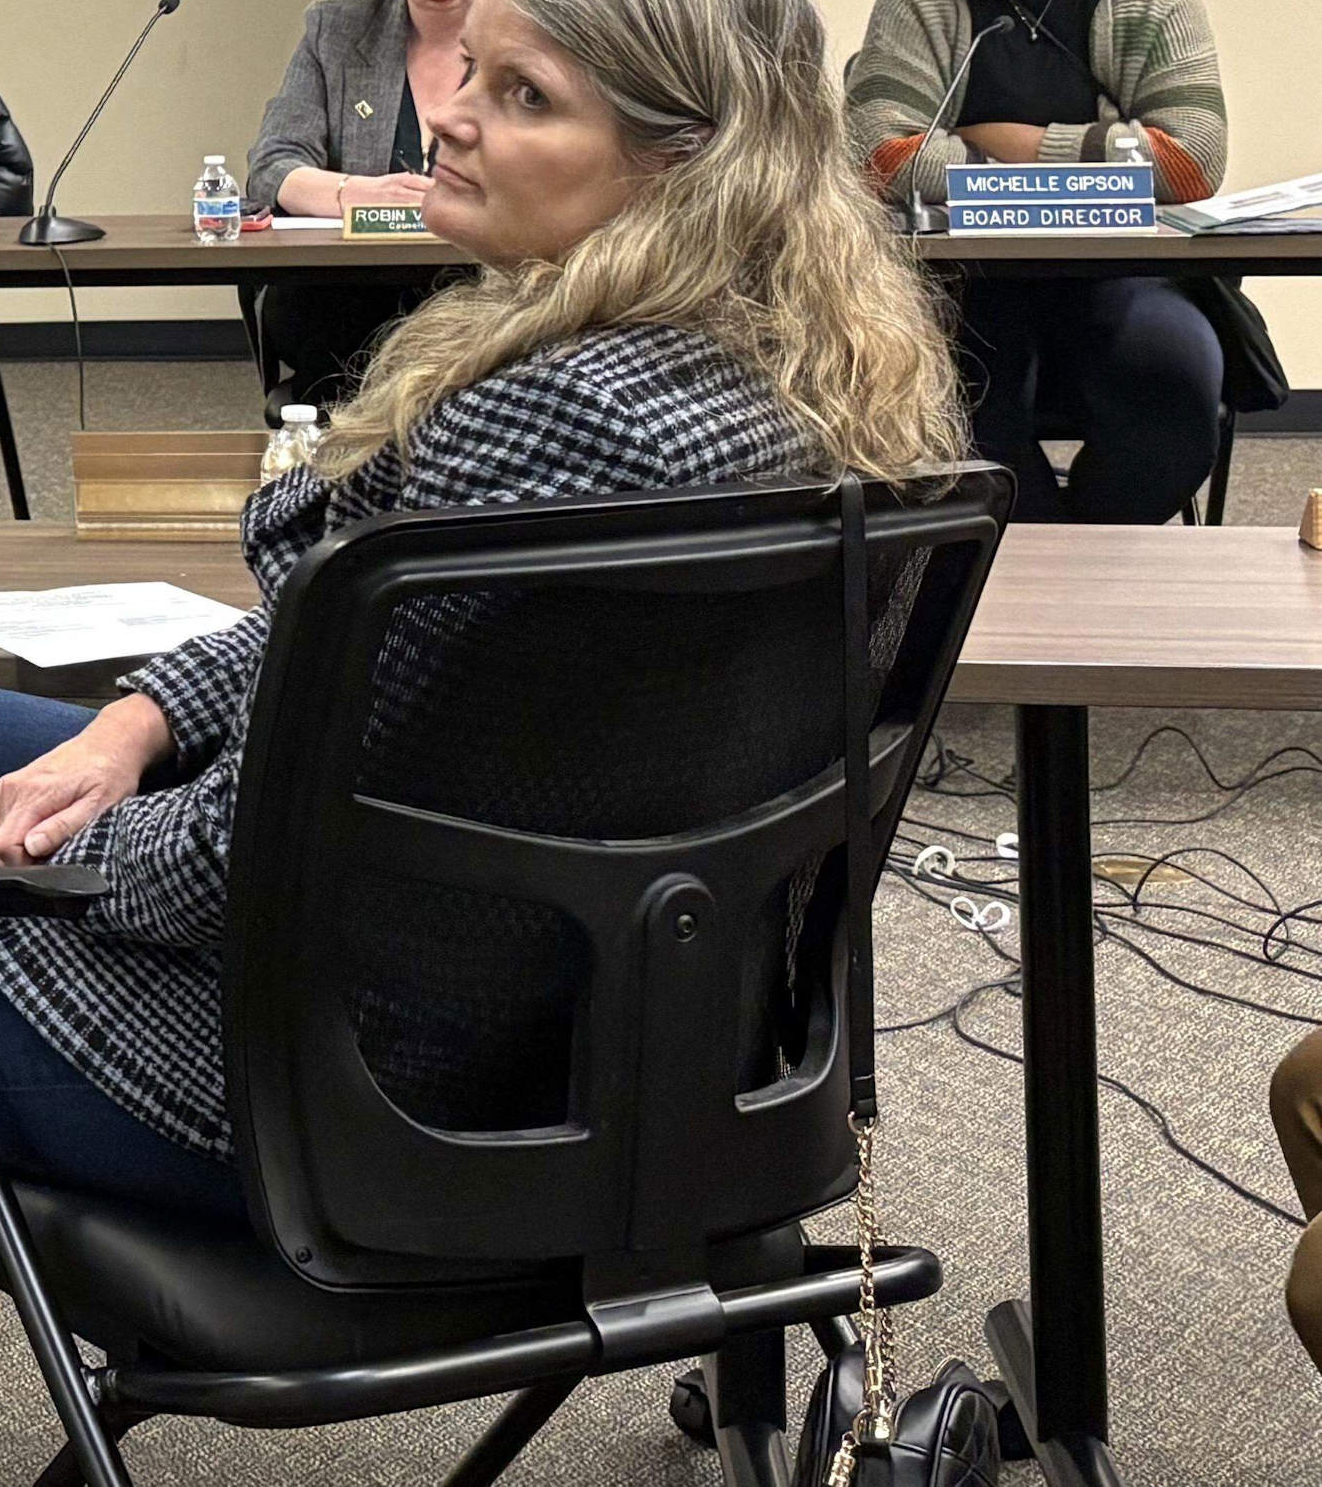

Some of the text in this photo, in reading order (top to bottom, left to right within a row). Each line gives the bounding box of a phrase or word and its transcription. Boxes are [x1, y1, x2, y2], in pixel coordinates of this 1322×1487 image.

[967, 176, 1133, 192] MICHELLE GIPSON
[356, 209, 405, 222] ROBIN
[963, 209, 1143, 225] BOARD DIRECTOR
